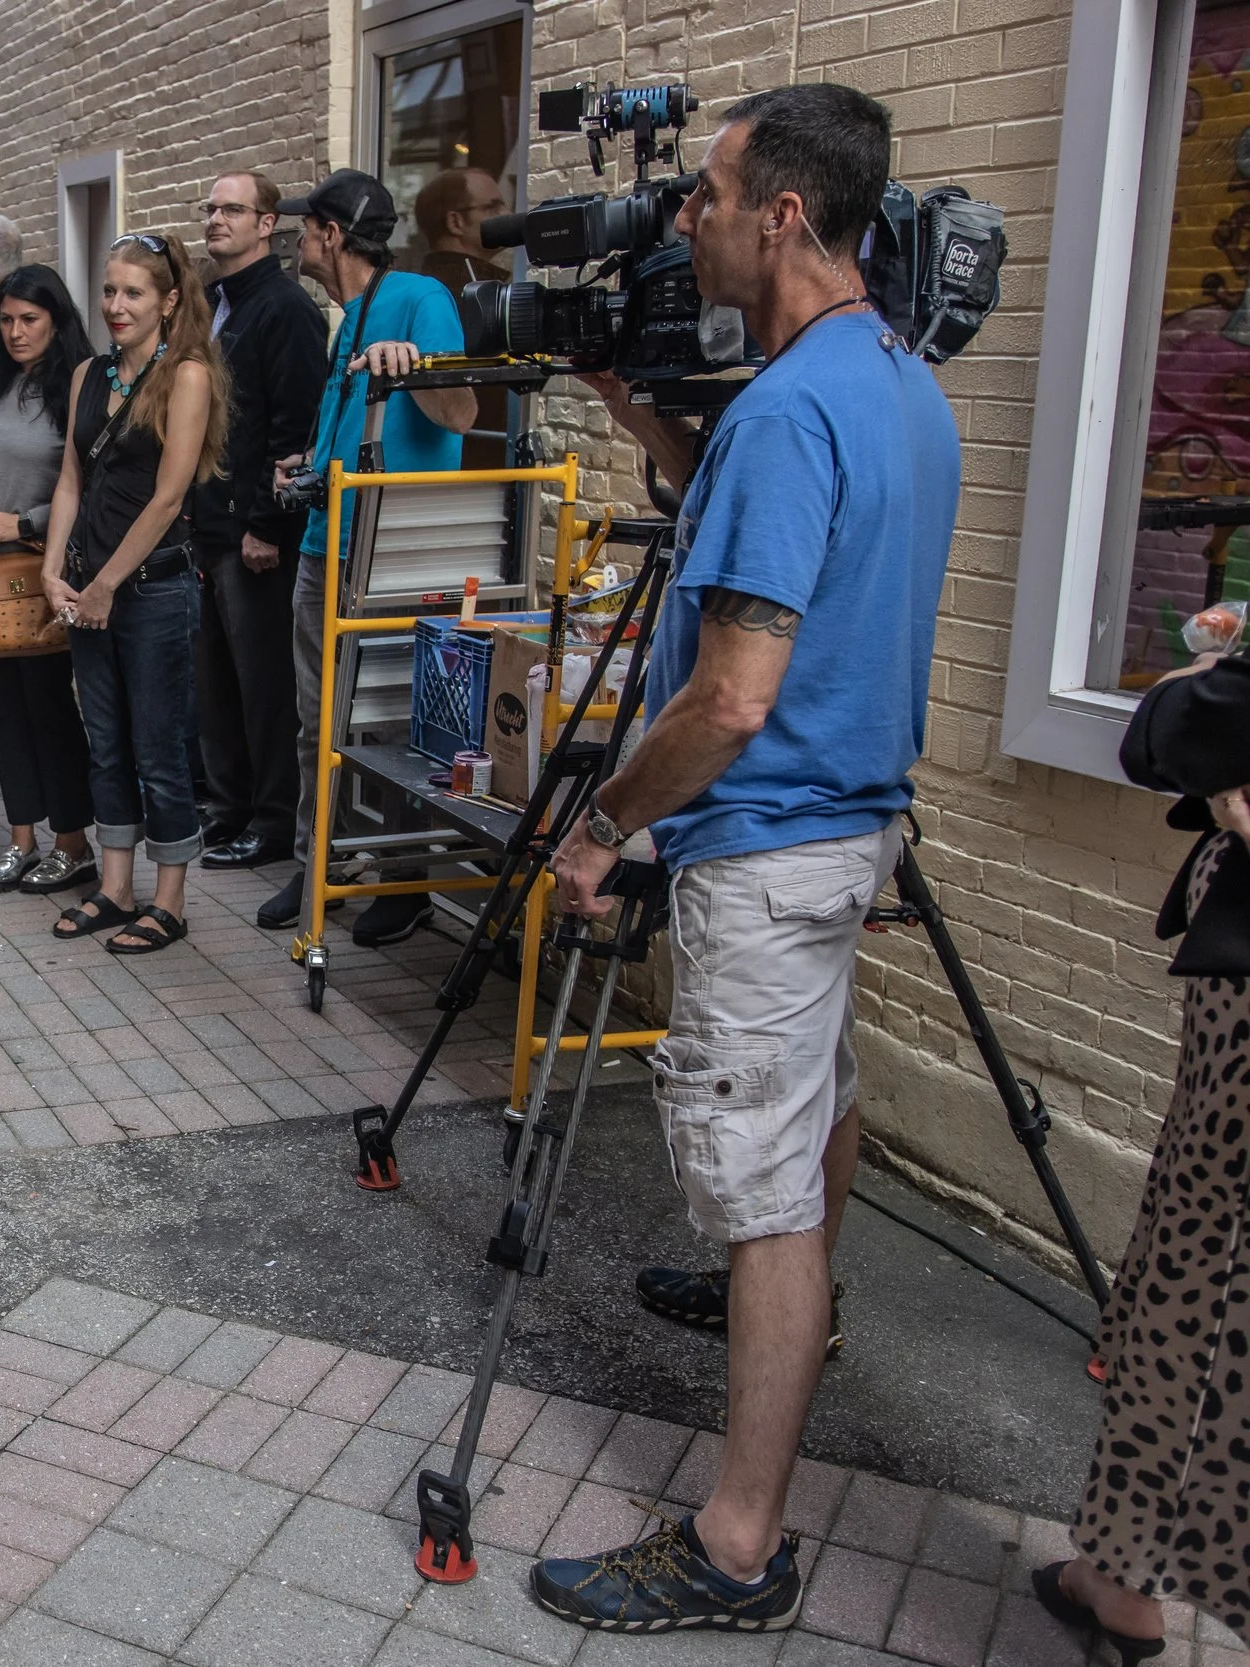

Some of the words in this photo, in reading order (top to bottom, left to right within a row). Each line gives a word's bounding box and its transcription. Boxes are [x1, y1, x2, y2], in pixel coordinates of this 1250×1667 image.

[950, 245, 979, 266] porta
[945, 260, 975, 279] brace
[495, 697, 526, 729] Utrecht
